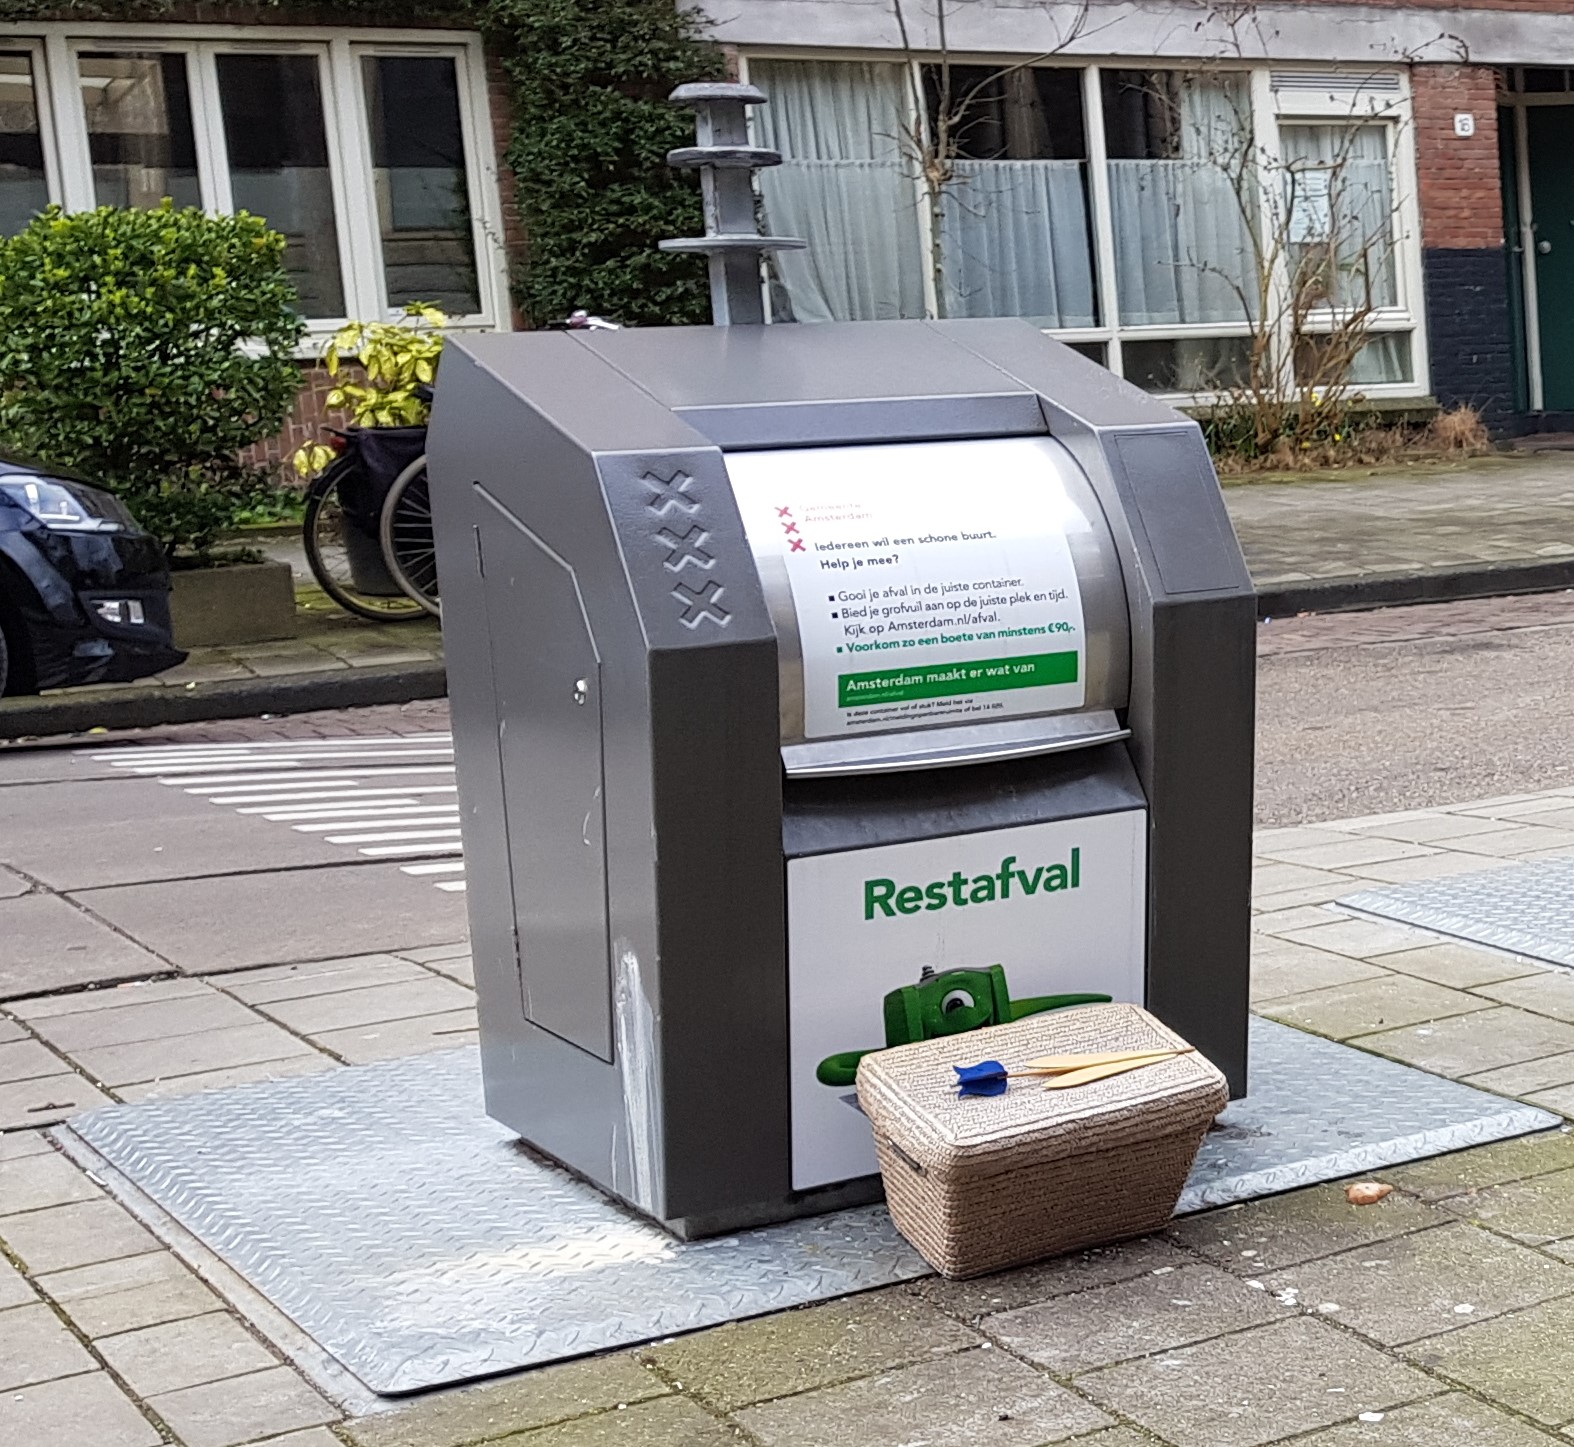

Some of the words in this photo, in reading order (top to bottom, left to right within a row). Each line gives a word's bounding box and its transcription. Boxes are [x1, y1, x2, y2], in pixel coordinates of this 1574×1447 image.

[805, 513, 872, 522] Amsterdam
[814, 541, 869, 551] Iedereen
[872, 537, 889, 547] wil
[893, 537, 915, 546] een
[918, 533, 958, 543] schone
[960, 531, 997, 540] buurt.
[820, 558, 849, 571] Help
[852, 557, 864, 570] je
[867, 554, 899, 566] mee?
[838, 589, 866, 601] Gooi
[869, 588, 880, 602] je
[882, 586, 908, 598] afval
[911, 585, 921, 596] in
[923, 583, 939, 594] de
[940, 582, 970, 596] juiste
[972, 577, 1024, 590] container.
[841, 606, 867, 619] Bied
[869, 606, 880, 619] je
[882, 601, 923, 618] grofvuil
[925, 602, 945, 611] aan
[946, 601, 962, 611] op
[963, 597, 977, 608] de
[979, 595, 1007, 609] juiste
[1009, 592, 1032, 606] plek
[1033, 593, 1046, 601] en
[1048, 589, 1068, 603] tijd.
[844, 624, 866, 638] Kijk
[868, 625, 884, 636] op
[888, 611, 1001, 632] Amsterdam.nl/afval.
[846, 640, 900, 653] Voorkom
[902, 640, 916, 648] zo
[917, 637, 939, 646] een
[941, 632, 973, 643] boete
[976, 631, 996, 640] van
[997, 627, 1046, 638] minstens
[846, 673, 923, 691] Amsterdam
[926, 668, 967, 683] maakt
[969, 668, 983, 678] er
[985, 664, 1010, 676] wat
[1013, 663, 1035, 673] van
[864, 847, 1080, 920] Restafval
